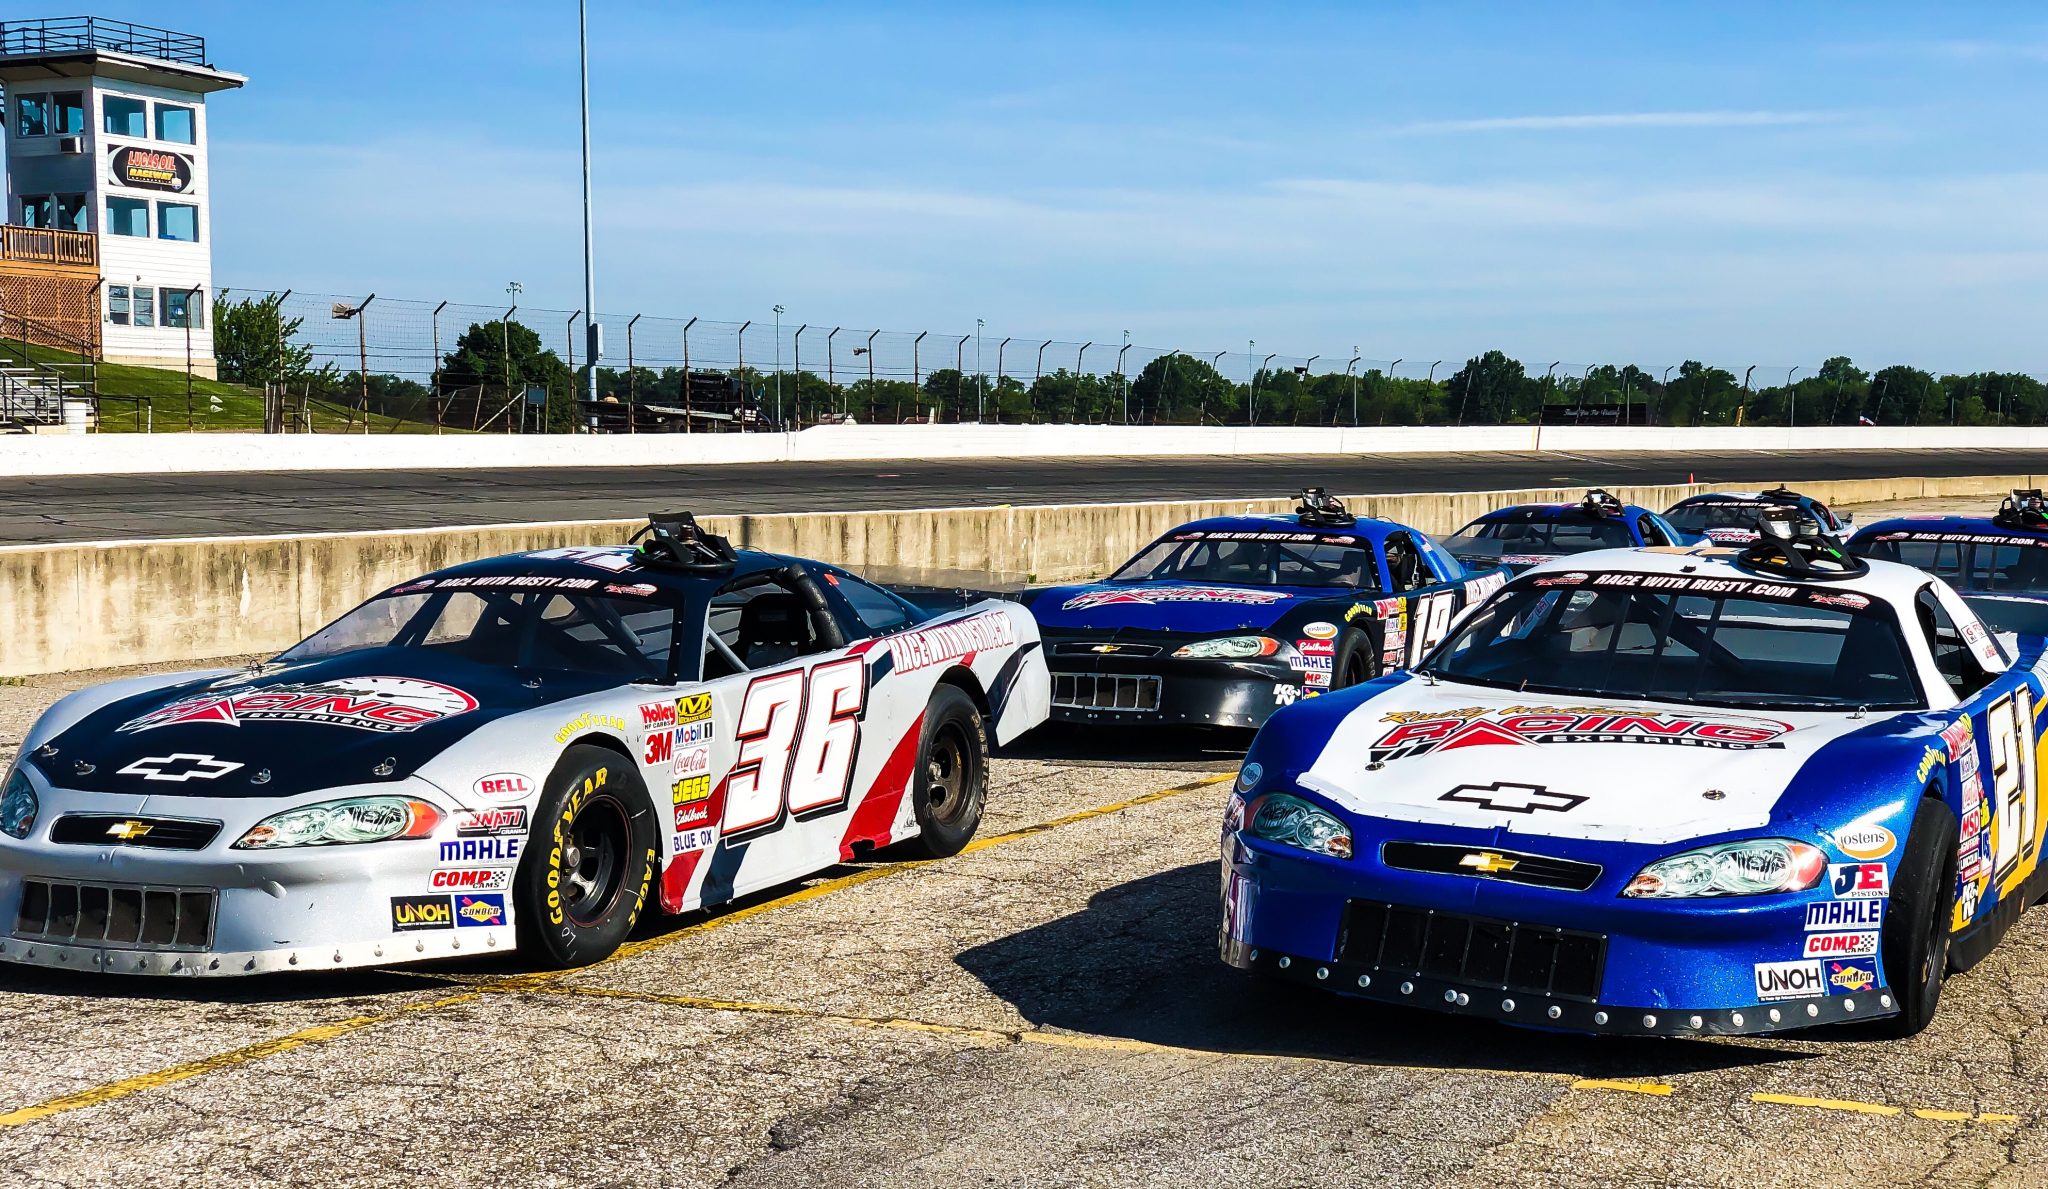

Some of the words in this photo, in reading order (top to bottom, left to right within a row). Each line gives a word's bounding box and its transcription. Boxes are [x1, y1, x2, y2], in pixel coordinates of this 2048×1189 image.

[128, 151, 160, 169] LUCAS
[159, 155, 176, 171] OIL
[129, 168, 174, 180] RACEWAY
[1231, 532, 1260, 540] WITH
[1911, 532, 1940, 541] RACE
[1941, 533, 1973, 542] WITH
[434, 577, 477, 588] RACE
[470, 576, 512, 587] WITH
[1592, 573, 1643, 587] RACE
[1640, 575, 1694, 590] WITH
[1344, 602, 1373, 622] GOODYEAR
[1376, 601, 1389, 619] 3M
[1410, 588, 1456, 669] 19
[1299, 642, 1334, 652] Edelbrock
[1289, 656, 1332, 669] MAHLE
[1305, 673, 1321, 681] MP
[247, 711, 408, 732] EXPERIENCE
[639, 703, 676, 726] Holley
[652, 720, 671, 729] CARBS
[1378, 706, 1497, 724] Rusty
[553, 711, 626, 745] GOODYEAR
[674, 723, 702, 745] Mobil
[705, 721, 713, 738] 1
[644, 730, 673, 765] 3M
[719, 654, 870, 840] 36
[1551, 734, 1773, 750] EXPERIENCE
[1916, 744, 1946, 784] GOODYEAR
[480, 778, 528, 794] BELL
[672, 773, 711, 805] JEGS
[1986, 682, 2038, 892] 21
[676, 807, 708, 825] Edelbrock
[1961, 809, 1980, 842] MSD
[439, 838, 519, 862] MAHLE
[547, 766, 609, 926] GOODYEAR
[673, 834, 697, 851] BLUE
[700, 829, 713, 846] OX
[1840, 832, 1886, 849] jostens
[432, 870, 492, 888] COMP
[472, 881, 500, 889] CAMS
[628, 847, 656, 928] EAGLE
[1834, 864, 1884, 897] JE
[395, 902, 451, 924] UNOH
[461, 905, 501, 917] SUNOCO
[1806, 901, 1880, 925] MAHLE
[1808, 935, 1861, 953] COMP
[1757, 965, 1822, 992] UNOH
[1833, 971, 1872, 984] SUNOCO
